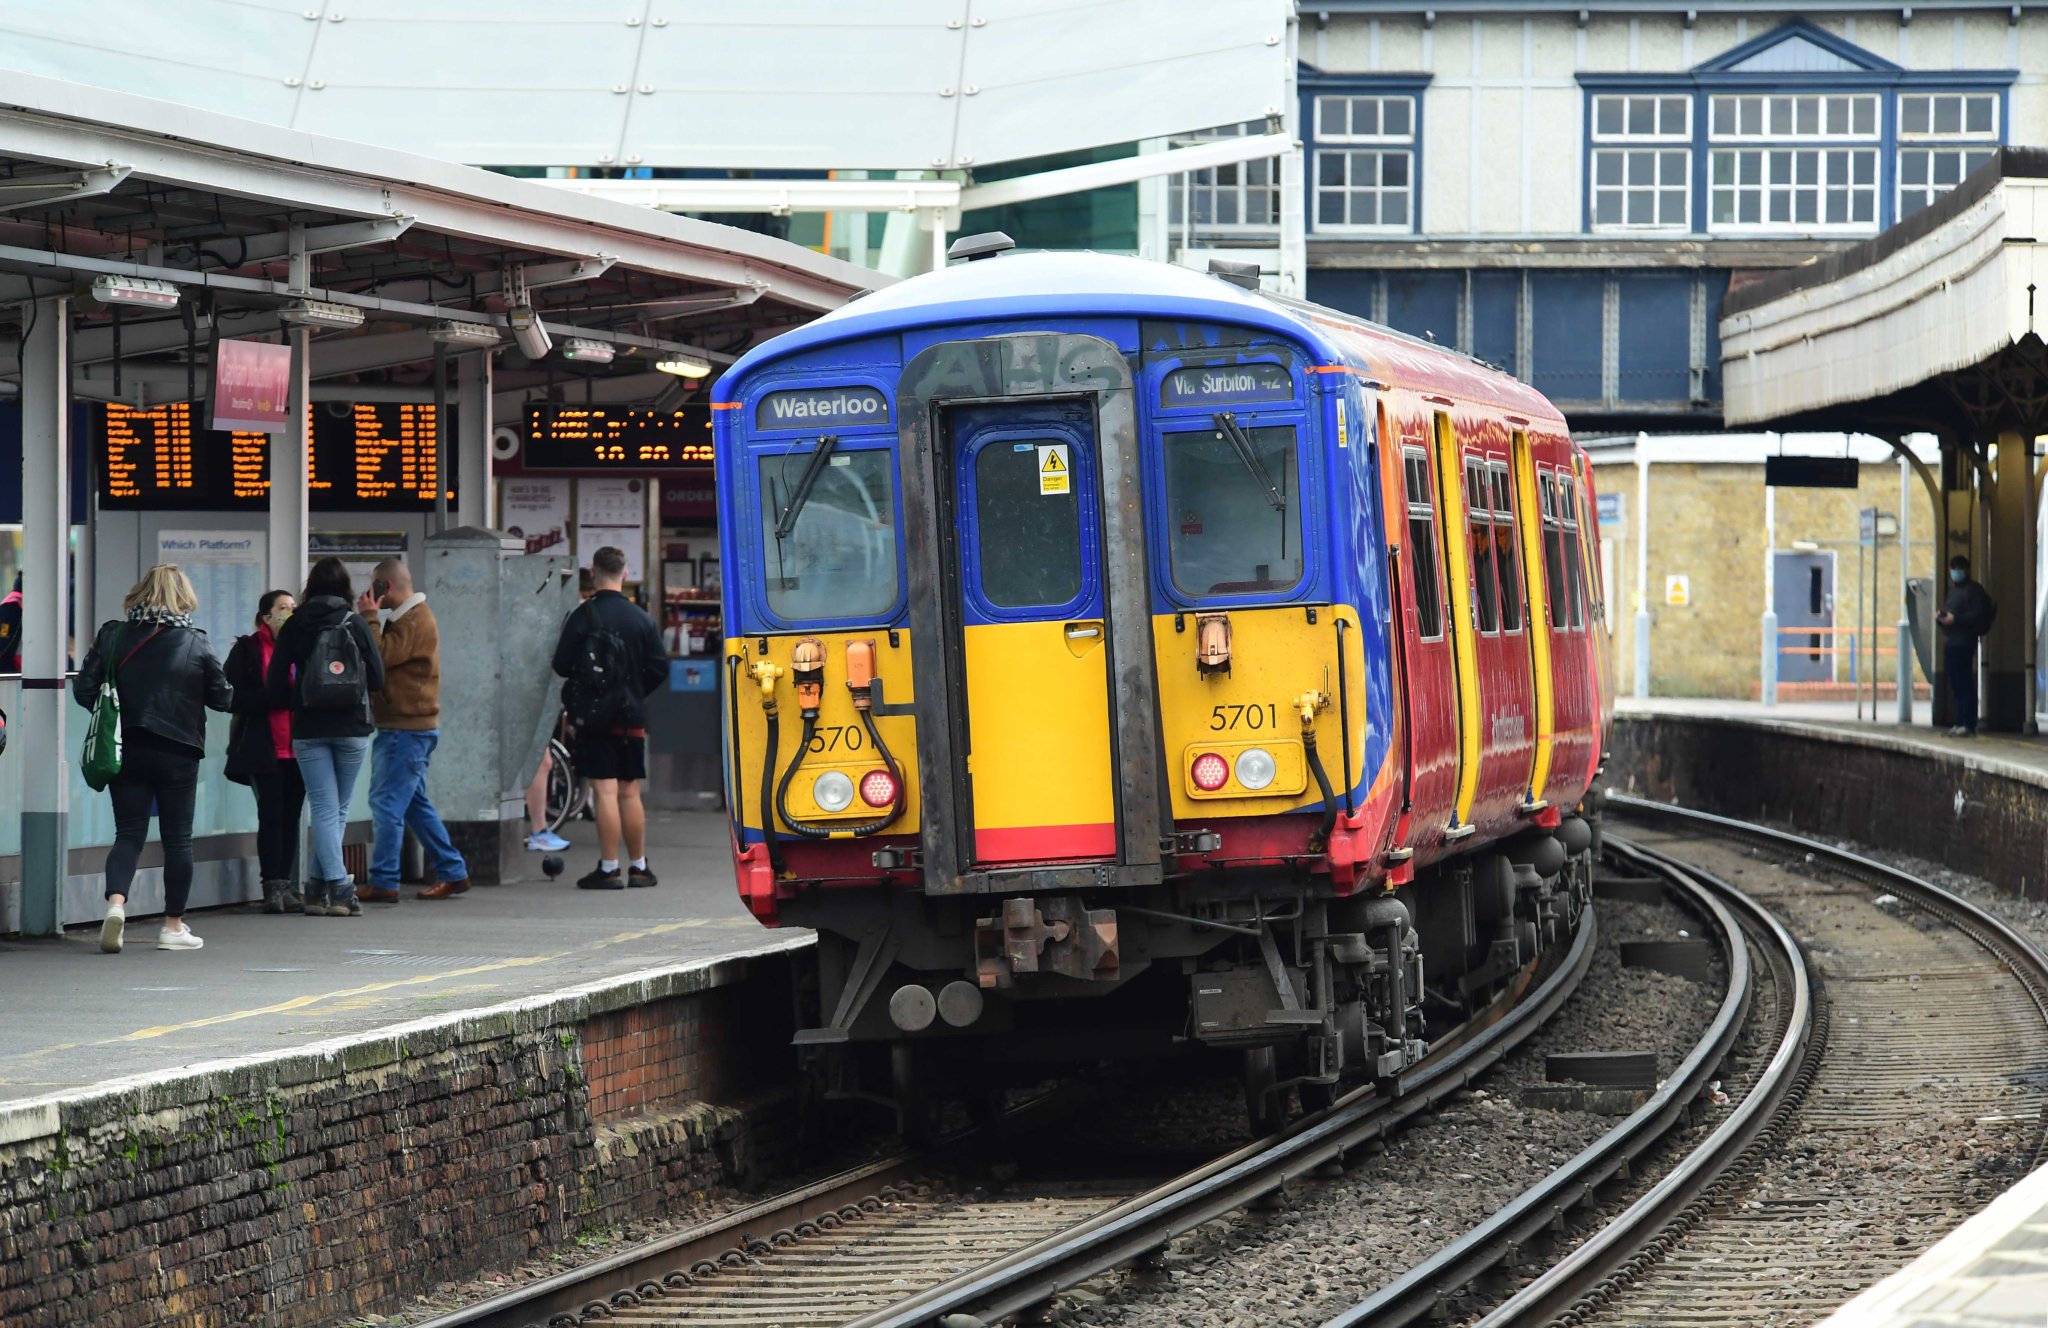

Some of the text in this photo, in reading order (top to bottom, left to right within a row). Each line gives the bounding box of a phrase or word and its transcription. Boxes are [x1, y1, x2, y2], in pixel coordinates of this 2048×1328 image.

[1174, 375, 1200, 395] Via
[1201, 373, 1255, 394] Surbiton
[772, 395, 878, 419] Waterloo
[667, 491, 714, 502] ORDER
[161, 539, 252, 550] Which Platform?
[1210, 703, 1277, 731] 5701
